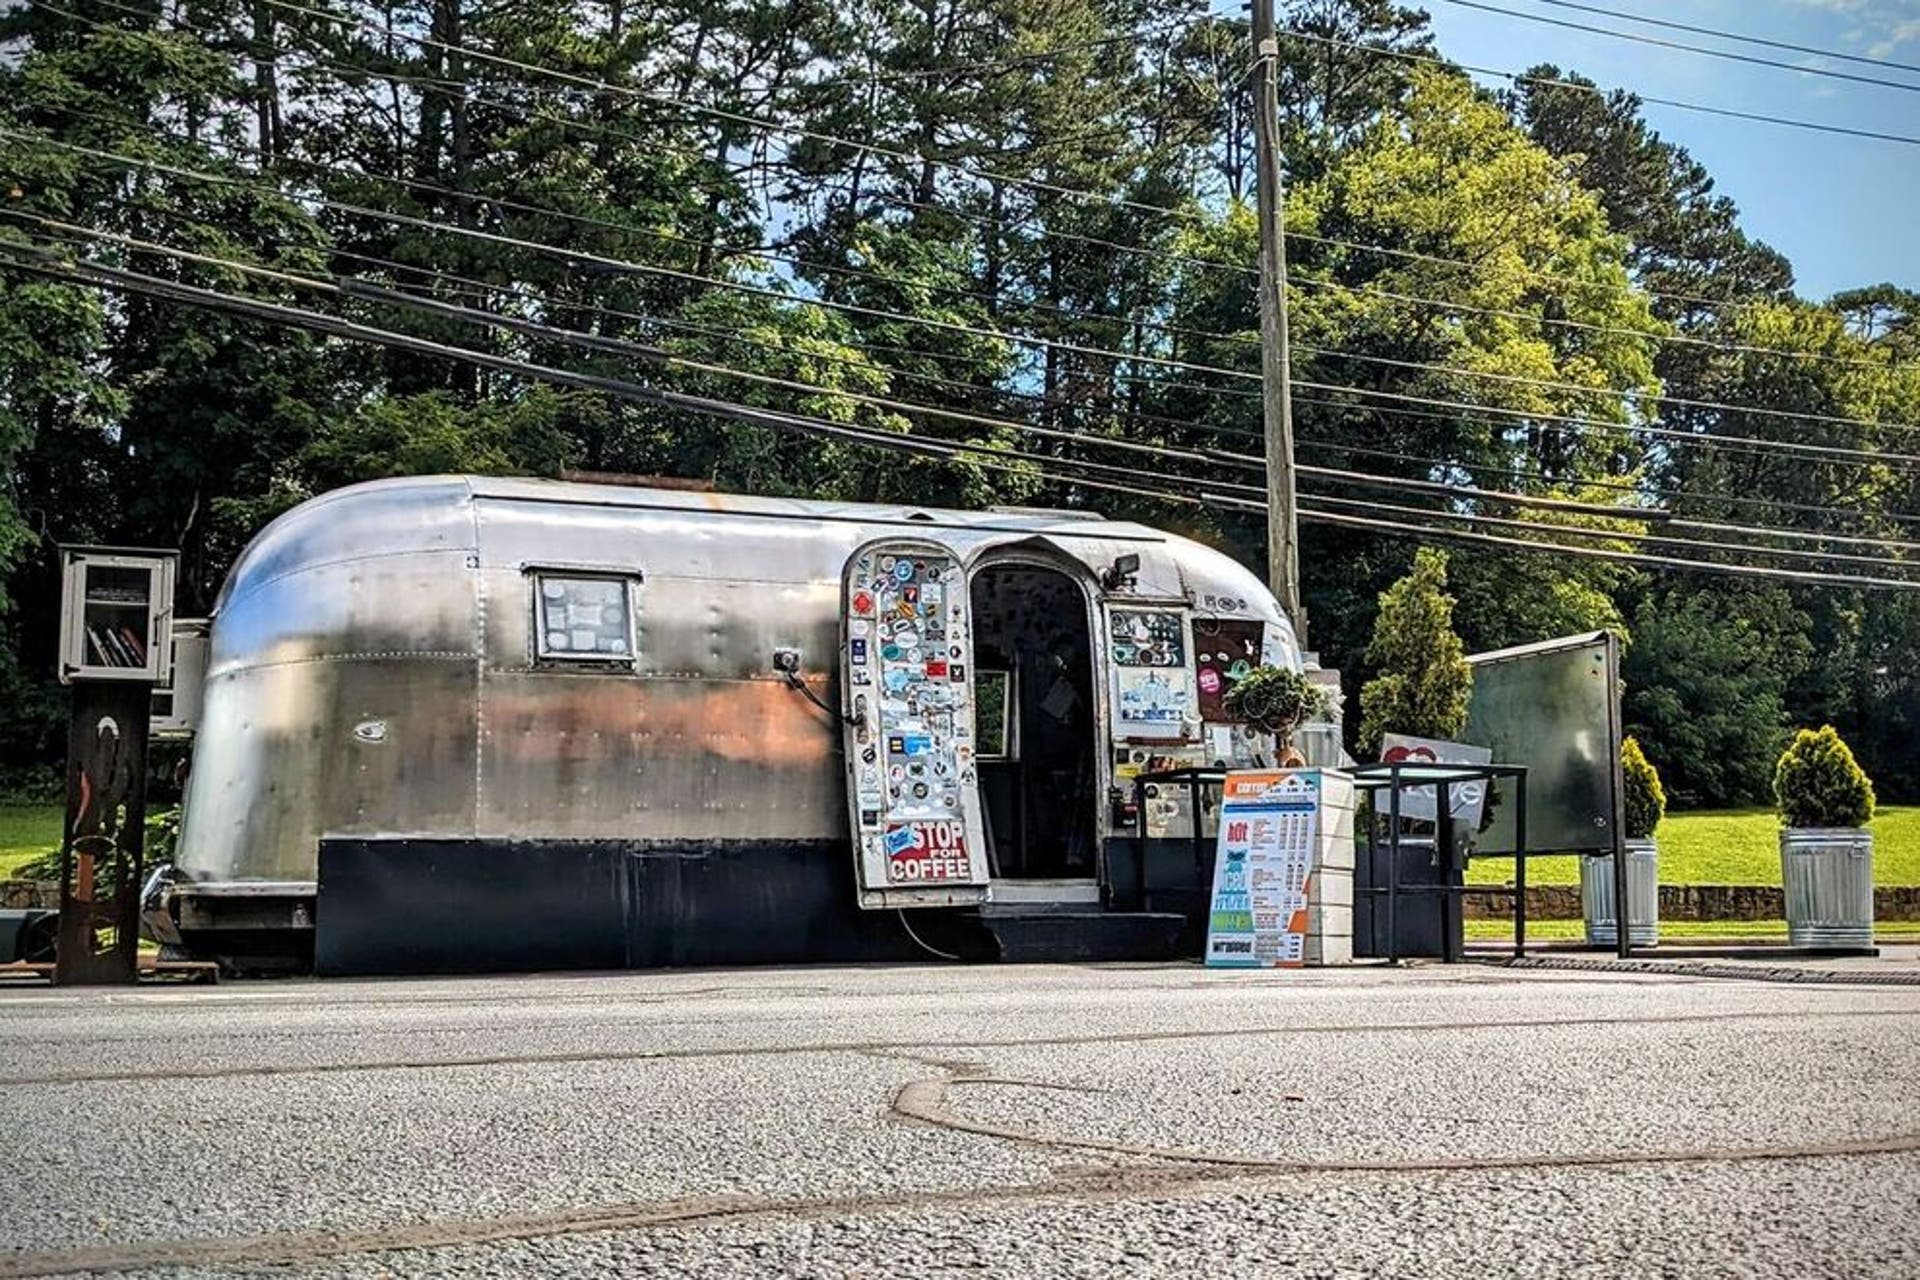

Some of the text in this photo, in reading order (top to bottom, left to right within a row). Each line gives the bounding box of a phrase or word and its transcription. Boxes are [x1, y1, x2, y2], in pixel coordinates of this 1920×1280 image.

[910, 821, 963, 849] STOP
[930, 848, 961, 858] FOR
[891, 859, 969, 880] COFFEE
